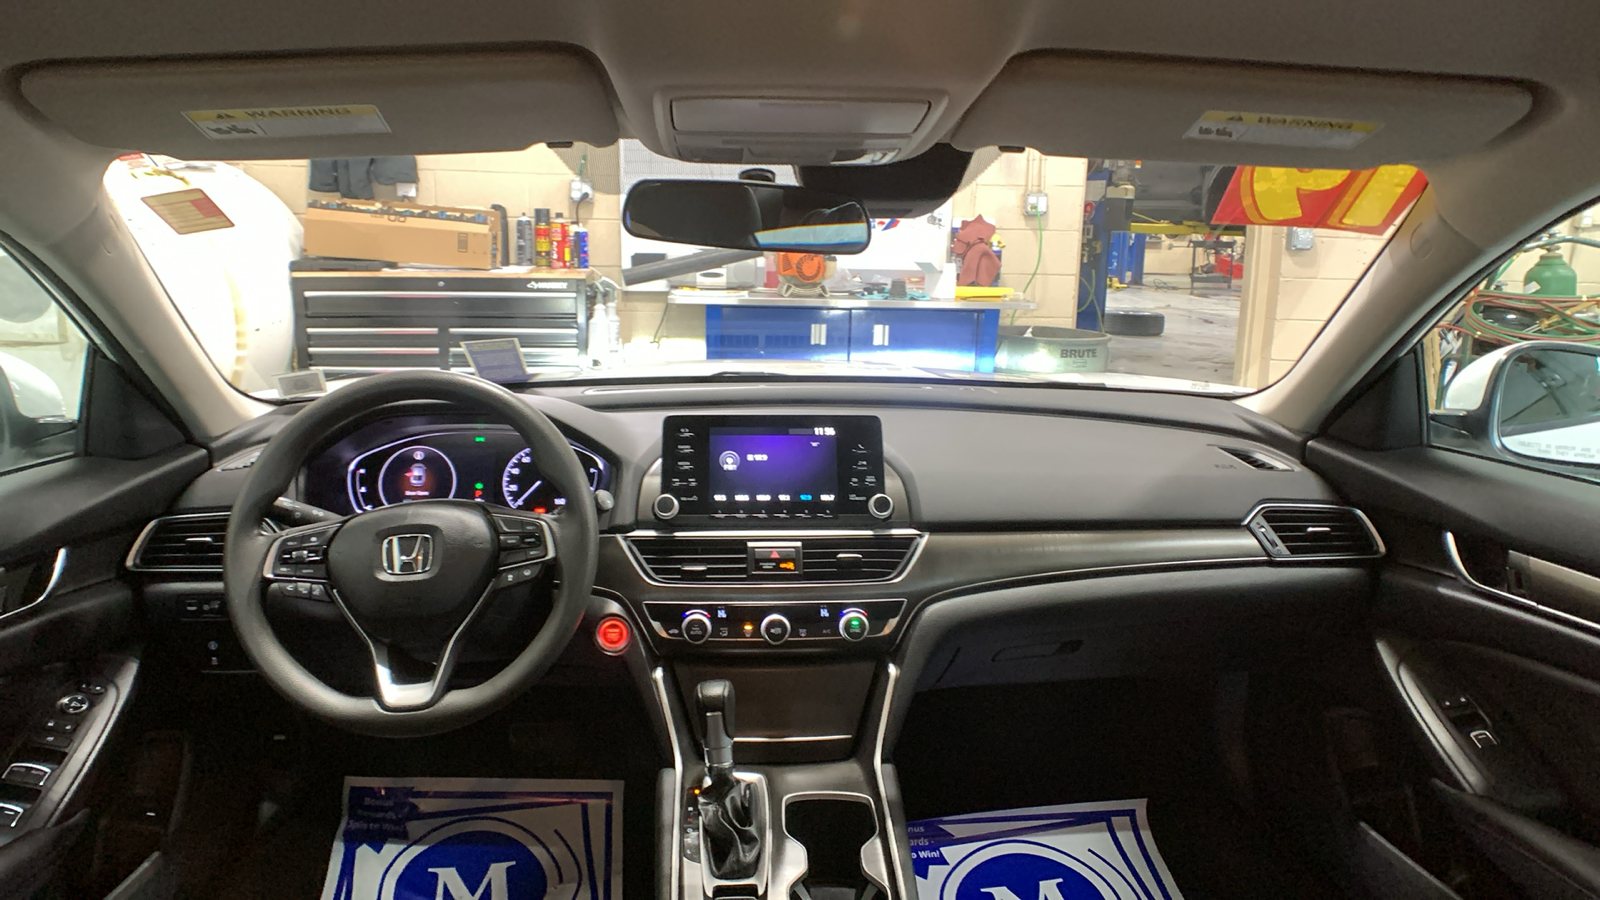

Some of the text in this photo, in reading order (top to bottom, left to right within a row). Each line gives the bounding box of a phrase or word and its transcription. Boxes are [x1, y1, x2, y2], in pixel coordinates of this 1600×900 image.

[245, 106, 352, 119] WARNING
[1257, 115, 1354, 130] WARNING
[1060, 348, 1097, 358] BRUTE
[918, 850, 941, 859] Win!
